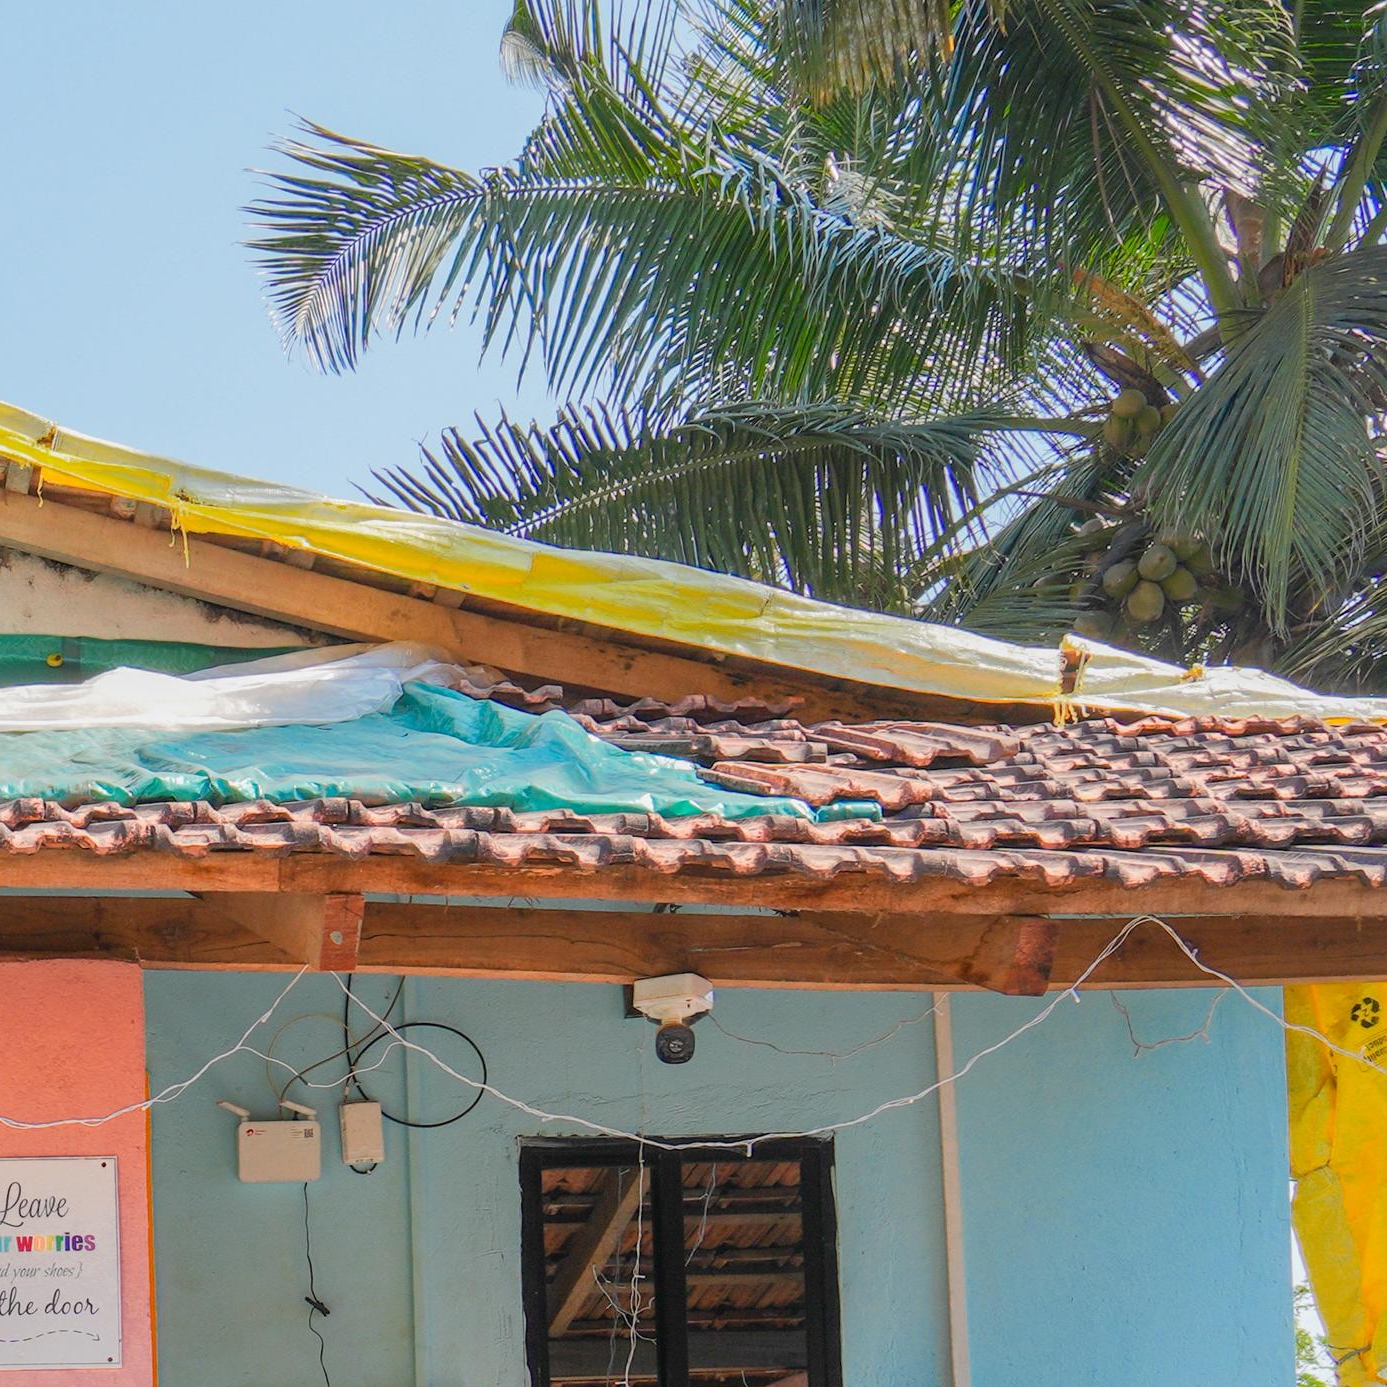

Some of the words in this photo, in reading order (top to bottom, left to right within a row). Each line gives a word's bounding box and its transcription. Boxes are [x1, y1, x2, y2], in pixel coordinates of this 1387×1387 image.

[16, 1231, 96, 1252] worries
[10, 1266, 41, 1284] your
[44, 1288, 100, 1316] door
